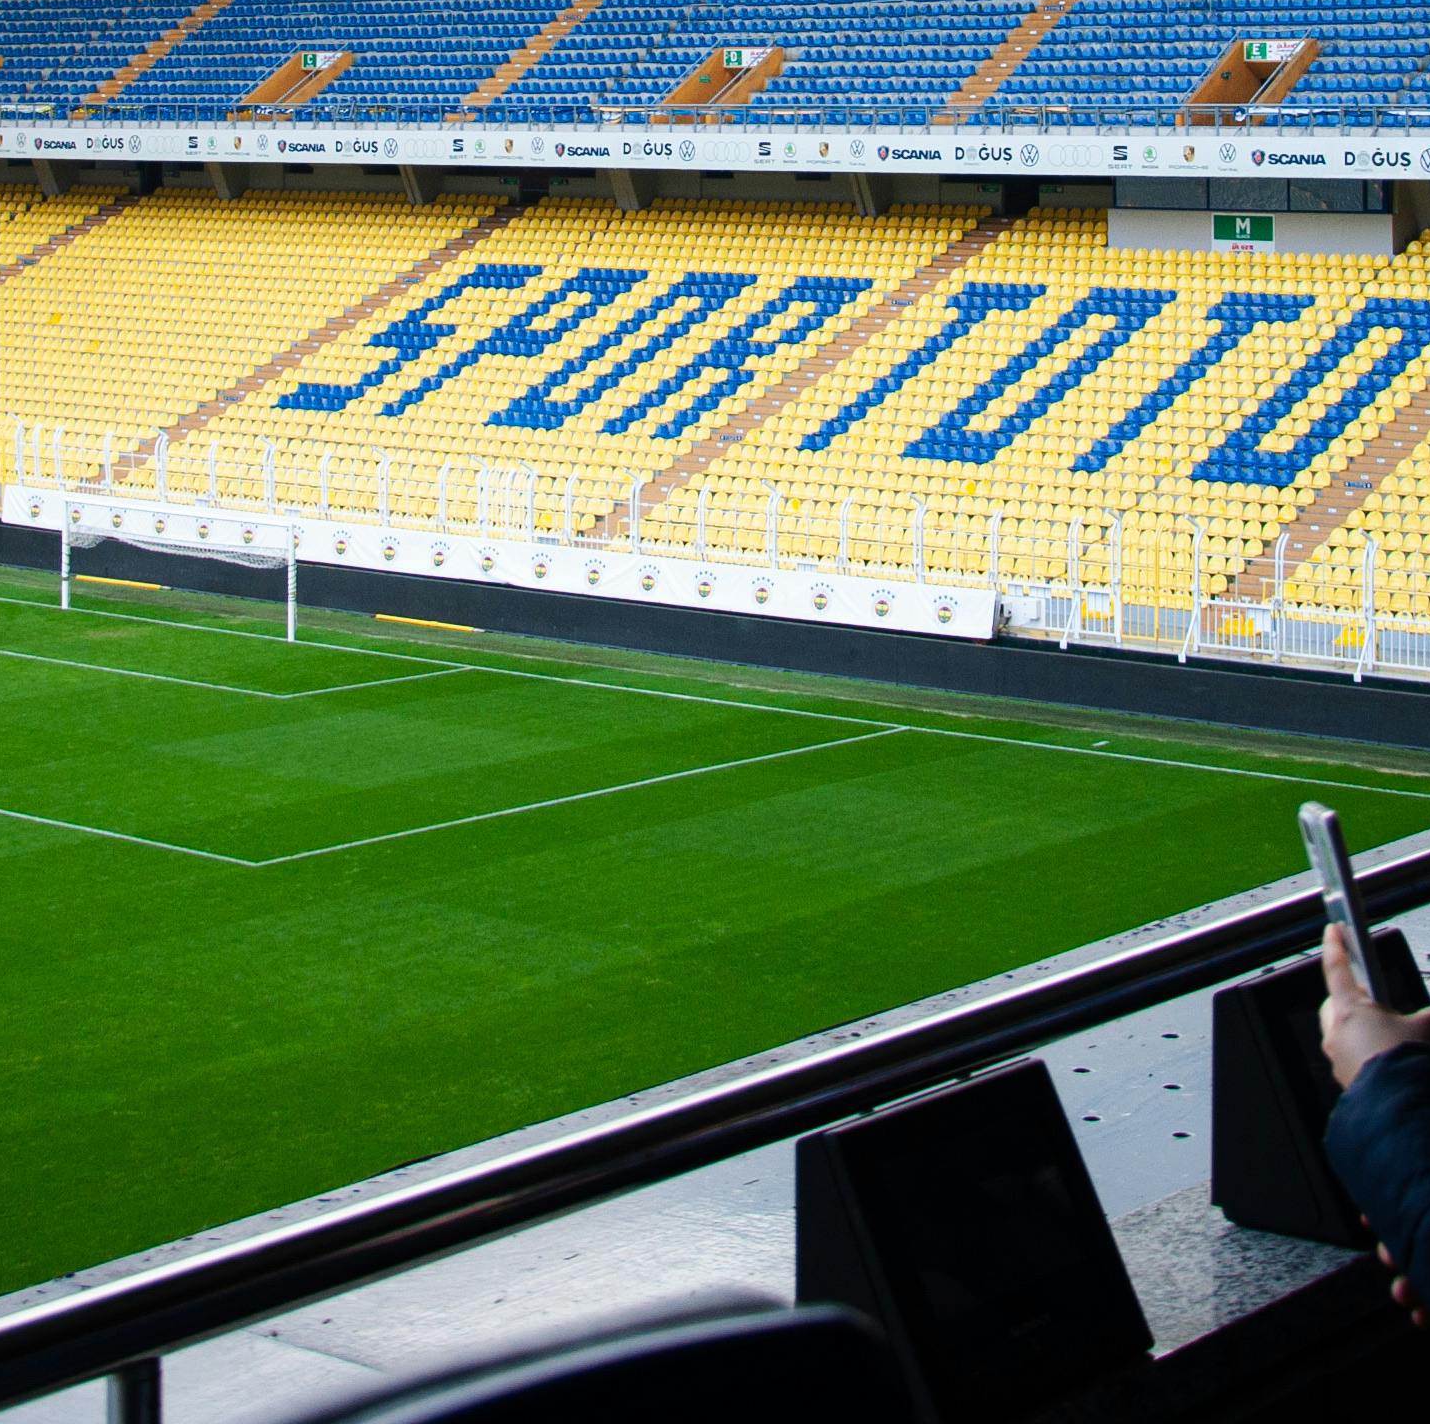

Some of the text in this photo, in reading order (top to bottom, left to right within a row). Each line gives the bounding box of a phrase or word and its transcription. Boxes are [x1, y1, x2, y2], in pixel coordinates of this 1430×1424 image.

[1253, 43, 1260, 55] E
[288, 143, 326, 152] SCANIA
[567, 146, 610, 157] SCANIA
[891, 149, 942, 160] SCANIA
[1268, 153, 1326, 165] SCANIA
[1235, 217, 1250, 234] M
[272, 263, 873, 439] SPOR
